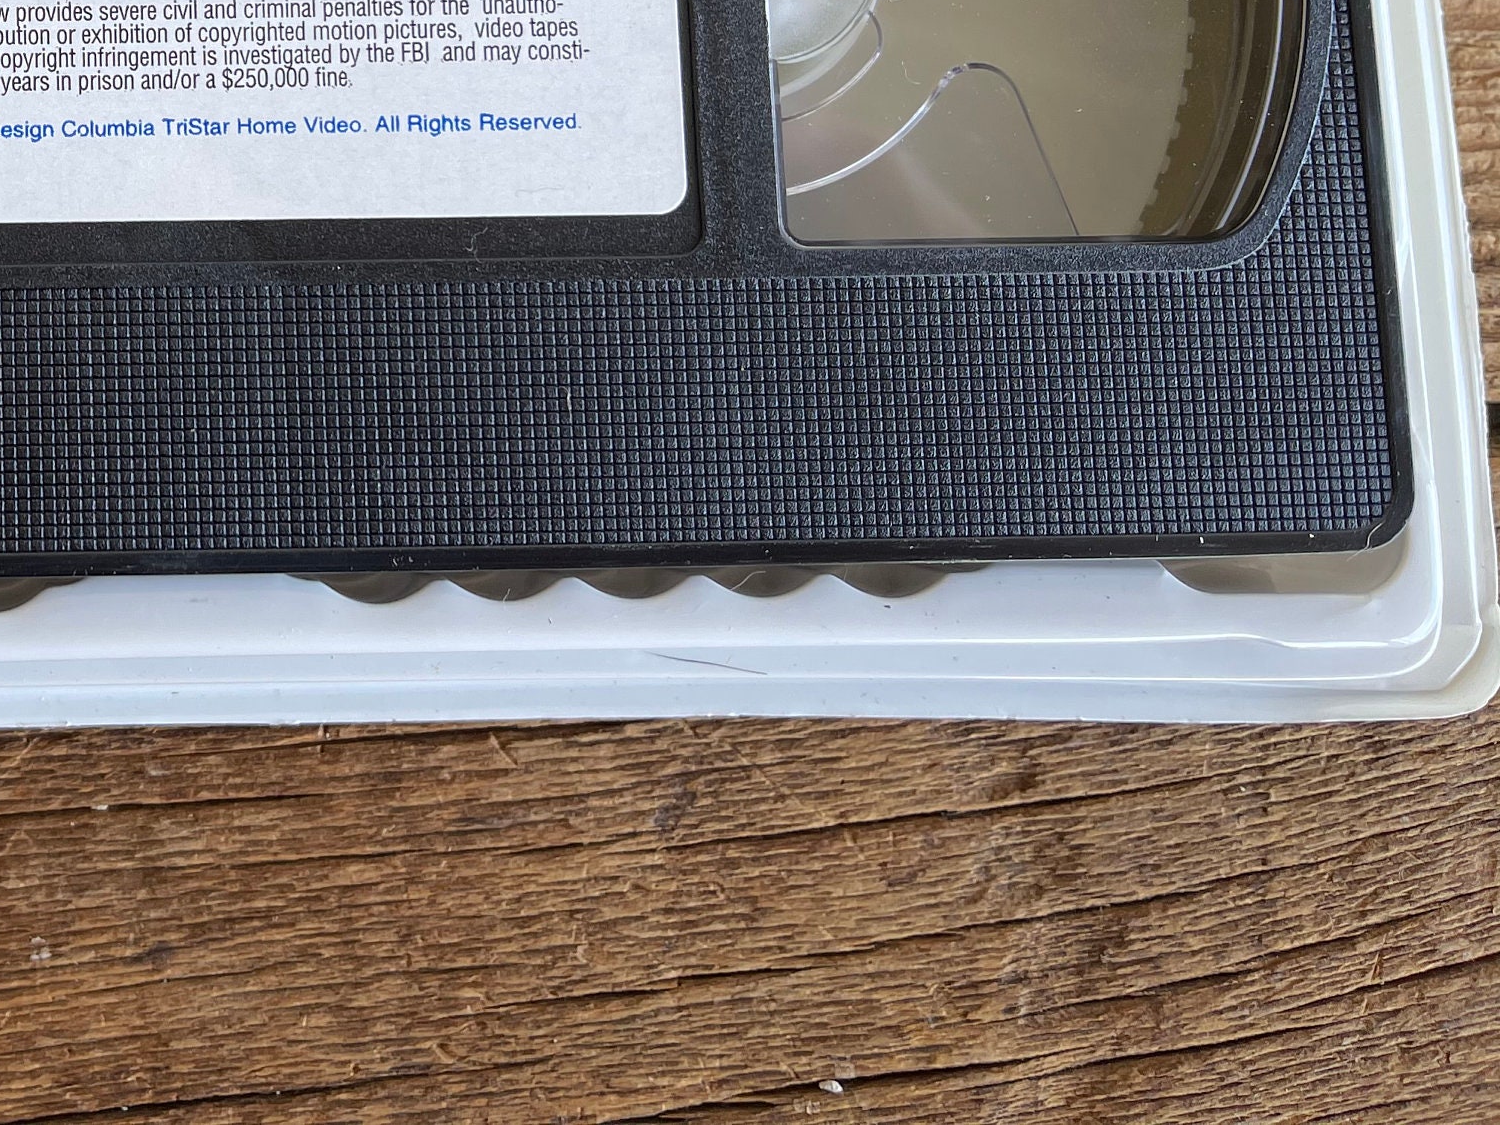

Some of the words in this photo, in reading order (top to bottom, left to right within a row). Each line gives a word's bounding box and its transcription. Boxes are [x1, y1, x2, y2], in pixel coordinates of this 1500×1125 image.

[16, 1, 93, 28] provides
[99, 5, 156, 21] severe
[163, 0, 197, 20] civil
[204, 0, 236, 19] and
[57, 29, 76, 44] or
[82, 23, 168, 44] exhibition
[175, 22, 192, 43] of
[198, 21, 305, 48] copyrighted
[313, 20, 377, 40] motion
[384, 19, 462, 44] pictures,
[474, 17, 523, 38] video
[529, 18, 578, 41] tapes
[82, 46, 197, 71] infringement
[203, 45, 217, 65] is
[224, 43, 331, 70] investigated
[339, 43, 360, 68] by
[366, 43, 394, 63] the
[401, 41, 429, 64] FBI
[441, 41, 476, 63] and
[483, 45, 521, 65] may
[528, 40, 590, 63] consti-
[0, 75, 50, 96] years
[56, 70, 71, 91] in
[79, 70, 134, 95] prison
[141, 69, 200, 91] and/or
[206, 73, 216, 89] a
[222, 65, 309, 93] $250,000
[315, 66, 353, 89] fine.
[61, 119, 155, 138] Columbia
[162, 118, 230, 136] TriStar
[237, 118, 296, 134] Home
[303, 116, 367, 134] Video.
[375, 115, 400, 132] All
[408, 114, 471, 137] Rights
[479, 113, 581, 131] Reserved.
